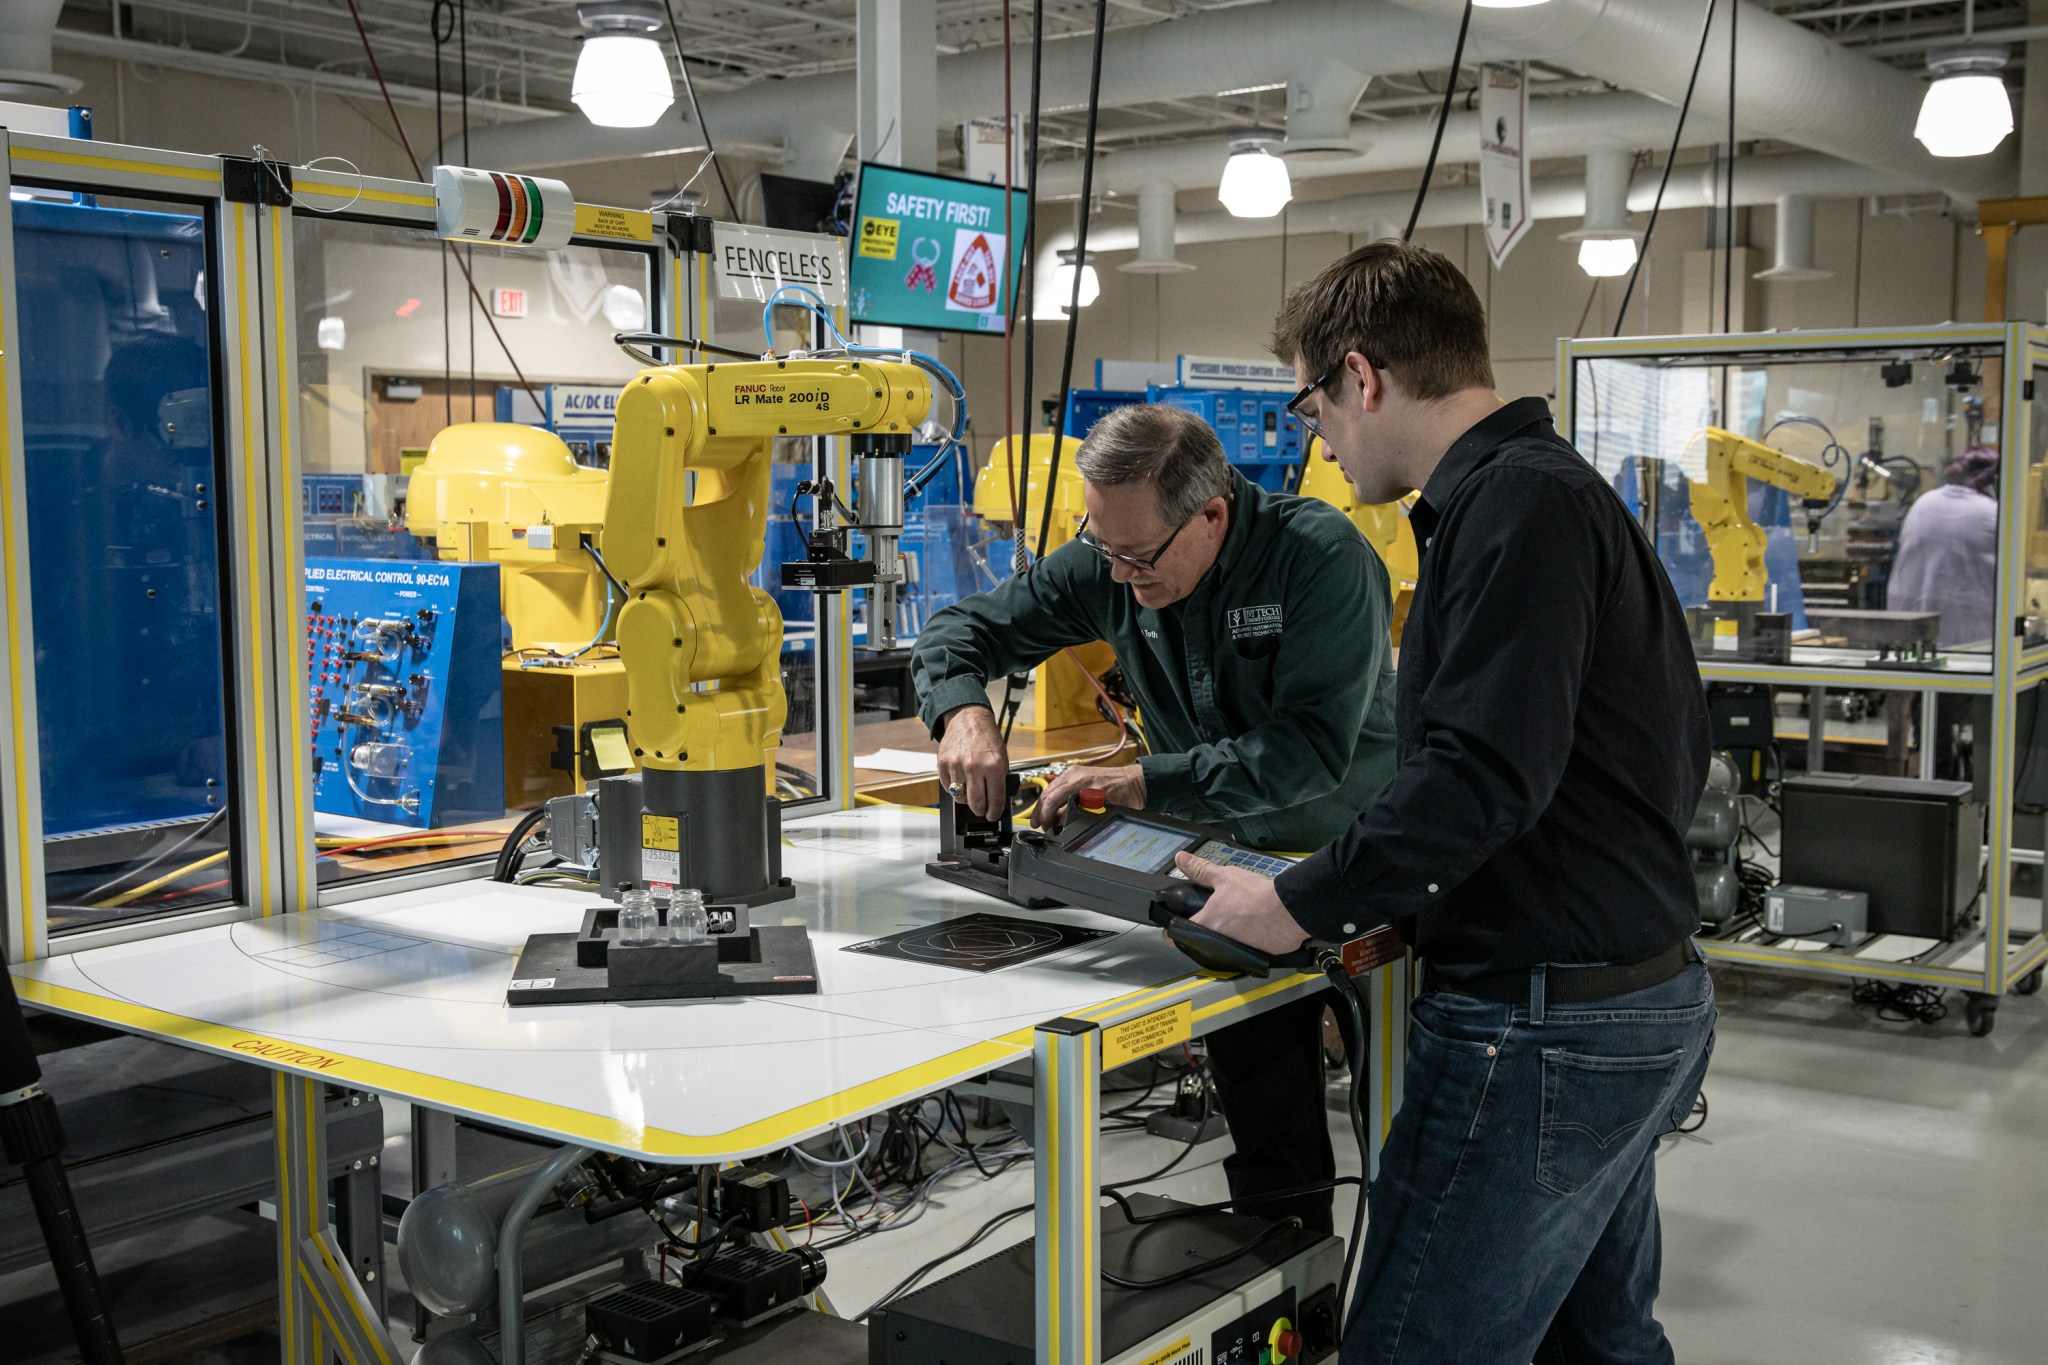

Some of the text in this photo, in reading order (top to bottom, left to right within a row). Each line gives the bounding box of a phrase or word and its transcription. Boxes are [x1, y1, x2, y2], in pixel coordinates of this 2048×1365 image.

[599, 210, 625, 219] WARNING
[886, 192, 991, 228] SAFETY FIRST!
[875, 224, 897, 237] EYE
[725, 245, 831, 280] FENCELESS
[501, 289, 523, 313] EXIT
[735, 384, 785, 393] FANUC Robot
[565, 394, 620, 410] AC/DC EL
[735, 395, 750, 404] LR
[756, 394, 783, 404] Mate
[816, 403, 830, 411] 4S
[326, 569, 374, 583] ELECTRICAL
[375, 571, 414, 585] CONTROL
[416, 574, 450, 586] 90-EC1A
[1255, 607, 1280, 618] TECH
[1121, 1026, 1130, 1034] THIS
[1130, 1022, 1142, 1032] CART
[1147, 1013, 1167, 1025] INTENDED
[1167, 1009, 1176, 1017] FOR
[1116, 1030, 1145, 1044] EDUCATIONAL
[1145, 1023, 1159, 1034] ROBOT
[1122, 1026, 1174, 1049] NOT FOR COMMERCIAL OR
[232, 1039, 344, 1069] CAUTION
[1132, 1043, 1155, 1054] INDUSTRIAL
